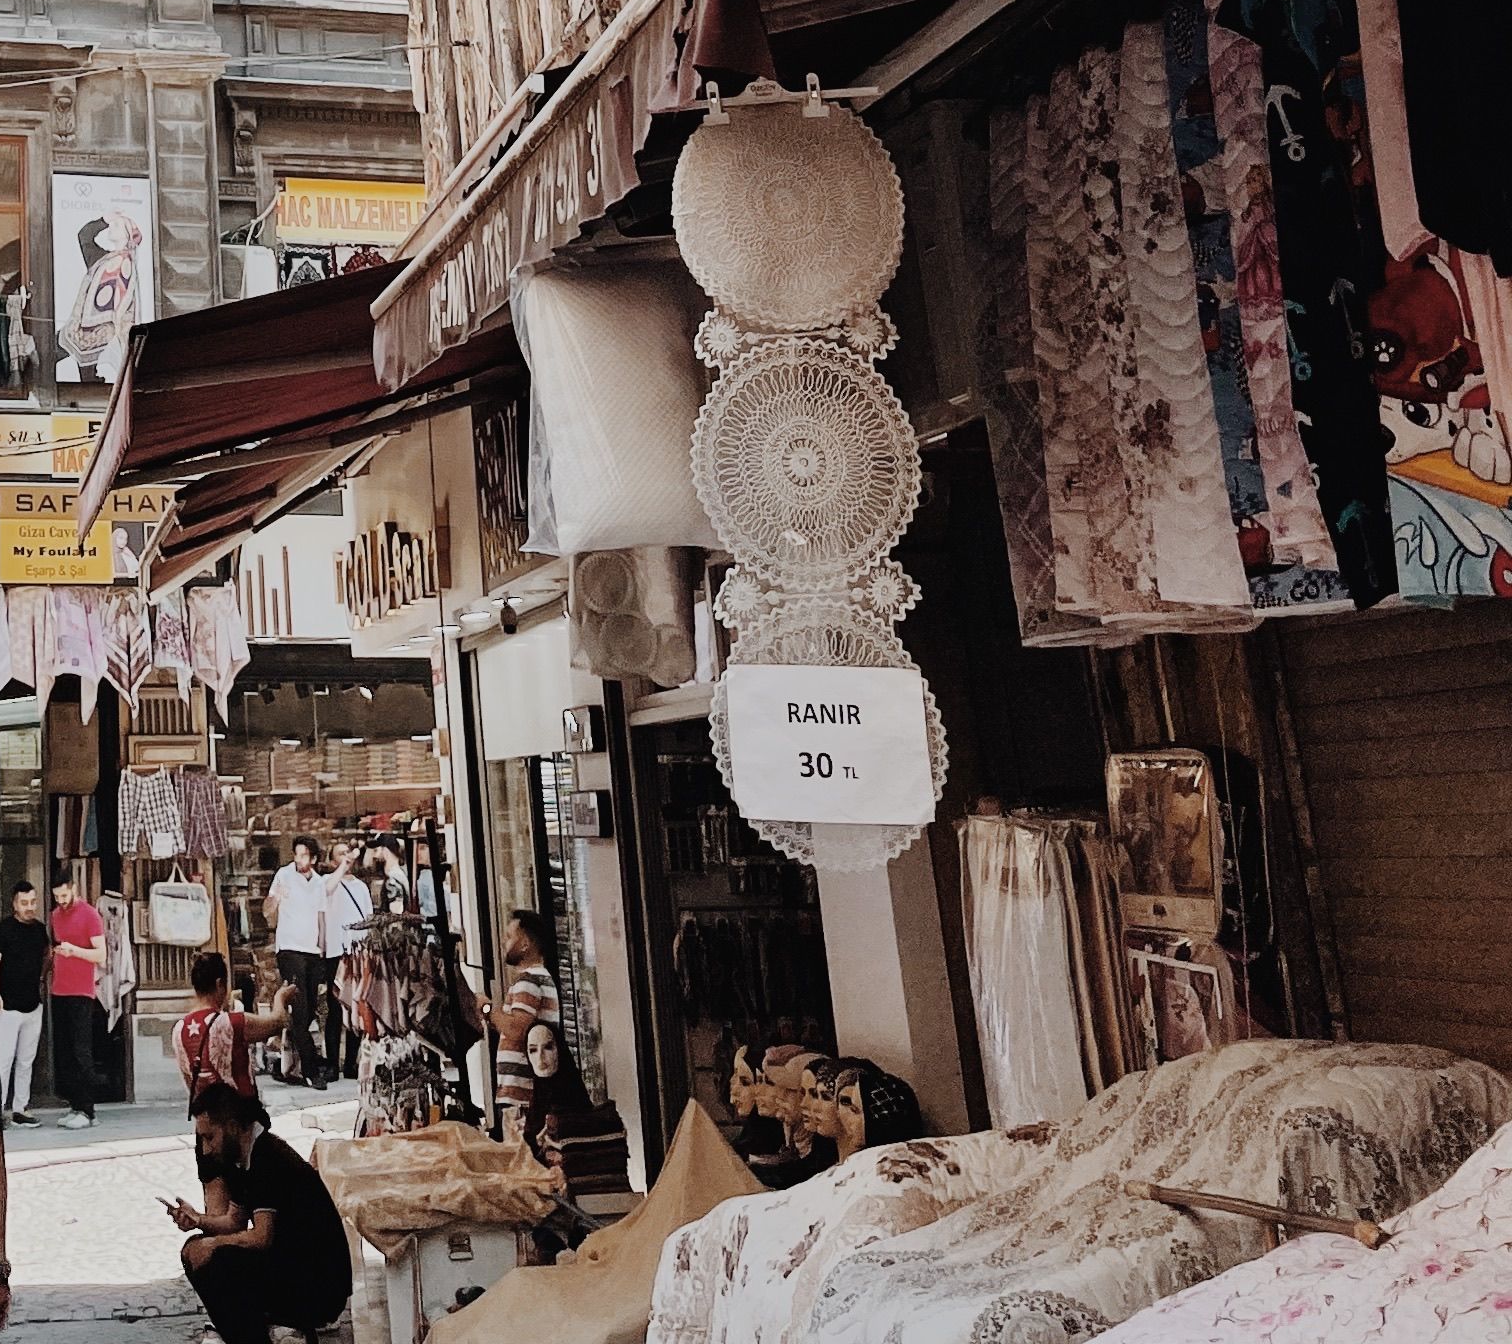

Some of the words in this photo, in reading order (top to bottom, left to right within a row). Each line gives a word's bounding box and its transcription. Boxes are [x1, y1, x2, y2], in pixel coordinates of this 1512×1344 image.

[15, 494, 84, 513] SAF
[19, 525, 46, 538] Giza
[49, 525, 92, 539] Cave
[13, 546, 34, 558] My
[25, 564, 56, 579] Eşarp
[59, 564, 66, 576] &
[70, 564, 88, 579] Şal
[787, 702, 861, 725] RANIR
[798, 751, 833, 778] 30
[842, 766, 859, 779] TL
